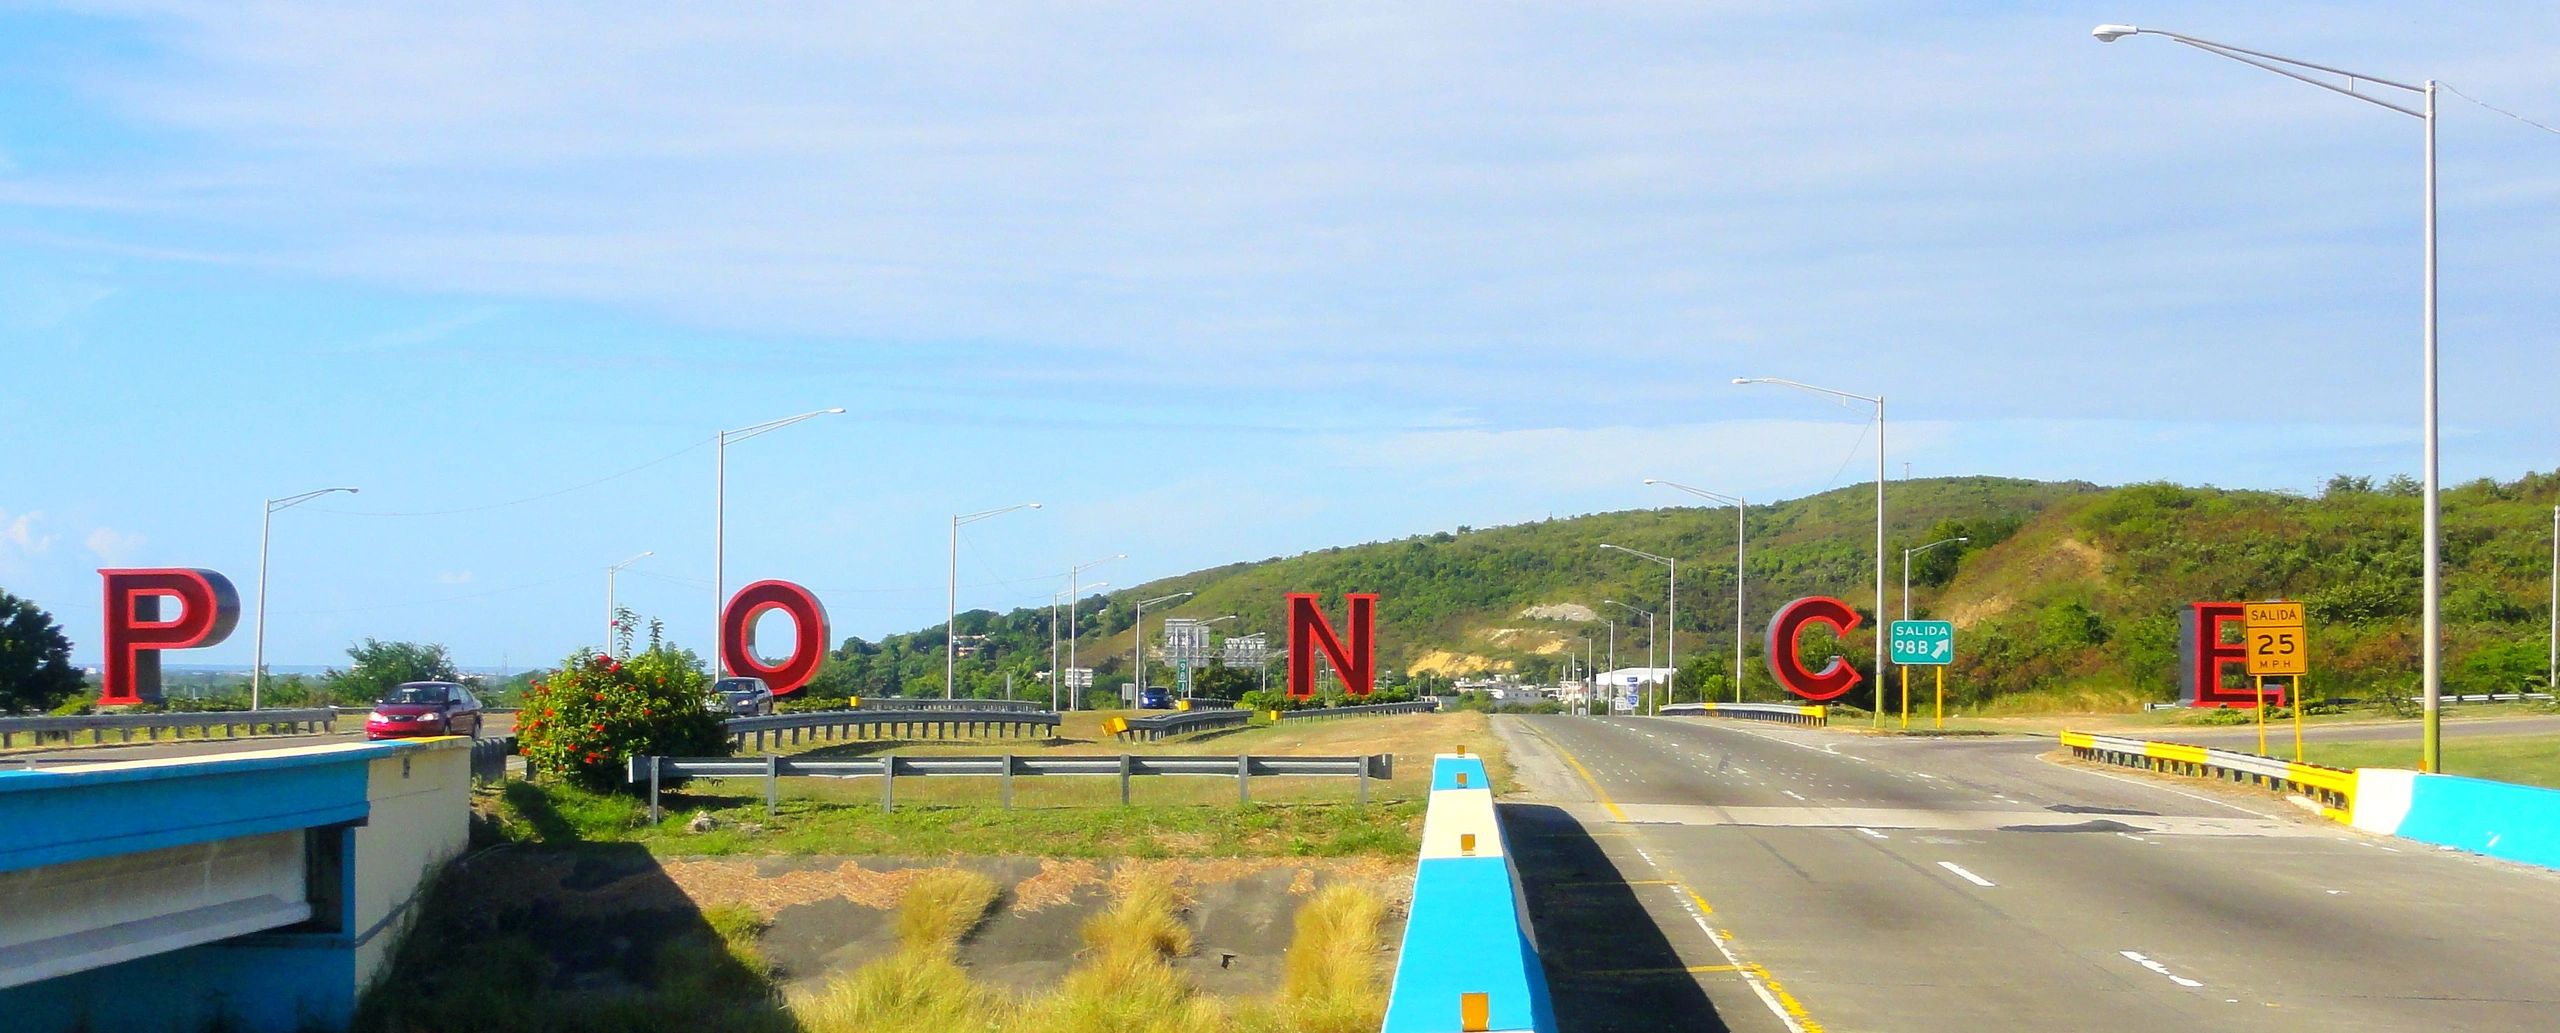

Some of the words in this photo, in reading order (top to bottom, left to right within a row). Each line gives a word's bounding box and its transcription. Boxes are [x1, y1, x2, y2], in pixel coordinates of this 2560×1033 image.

[2251, 608, 2297, 621] SALIDA
[1896, 626, 1948, 636] SALIDA
[2257, 633, 2295, 656] 25
